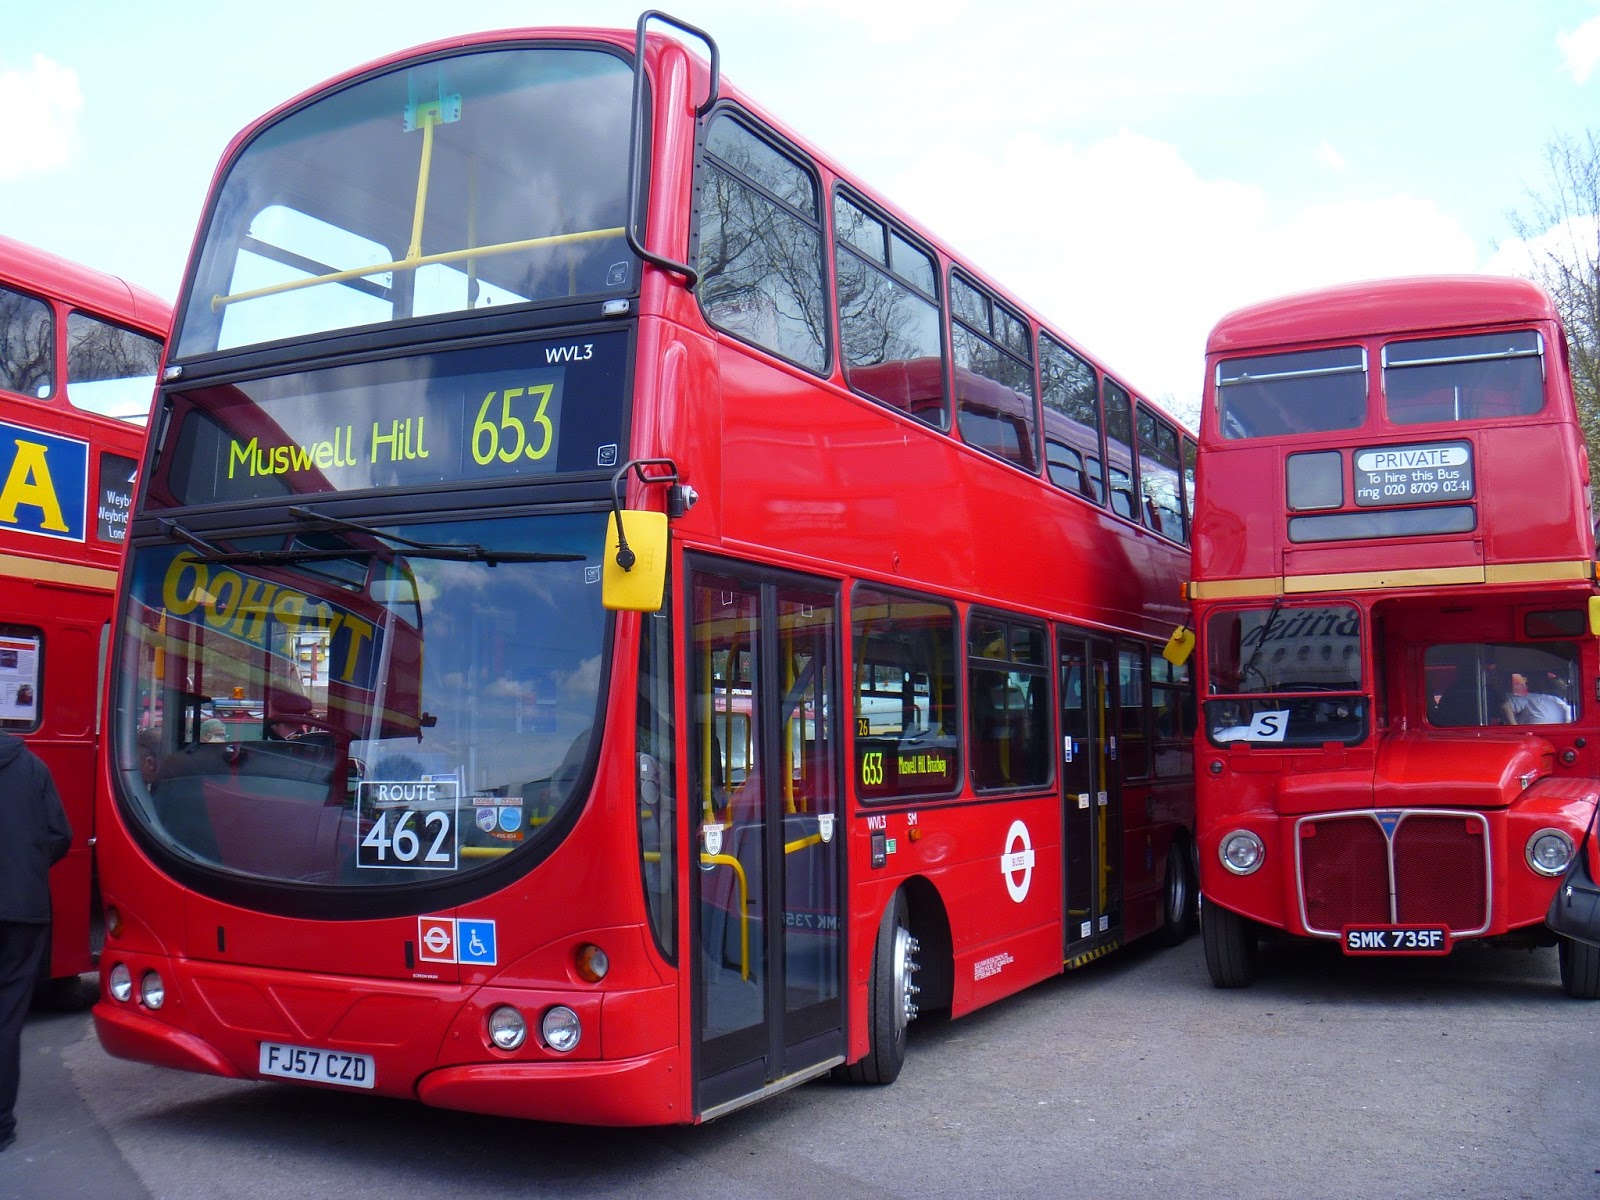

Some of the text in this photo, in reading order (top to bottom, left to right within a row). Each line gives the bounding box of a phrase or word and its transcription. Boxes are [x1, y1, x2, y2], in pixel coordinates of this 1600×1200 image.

[545, 344, 594, 364] WVL3
[471, 383, 555, 466] 653
[228, 416, 429, 480] Muswell Hill
[1375, 450, 1450, 469] PRIVATE
[1366, 468, 1460, 484] To hire this Bus
[1357, 479, 1470, 500] ring 020 8709 0341
[858, 719, 869, 737] 26
[1256, 715, 1279, 737] S
[862, 752, 883, 786] 653
[898, 755, 917, 775] Muswell
[917, 755, 927, 774] Hill
[378, 784, 437, 801] ROUTE
[867, 812, 918, 830] WVL3 SM
[360, 811, 450, 862] 462
[1348, 930, 1443, 949] SMK 735F
[267, 1046, 366, 1082] FJ57 CZD
